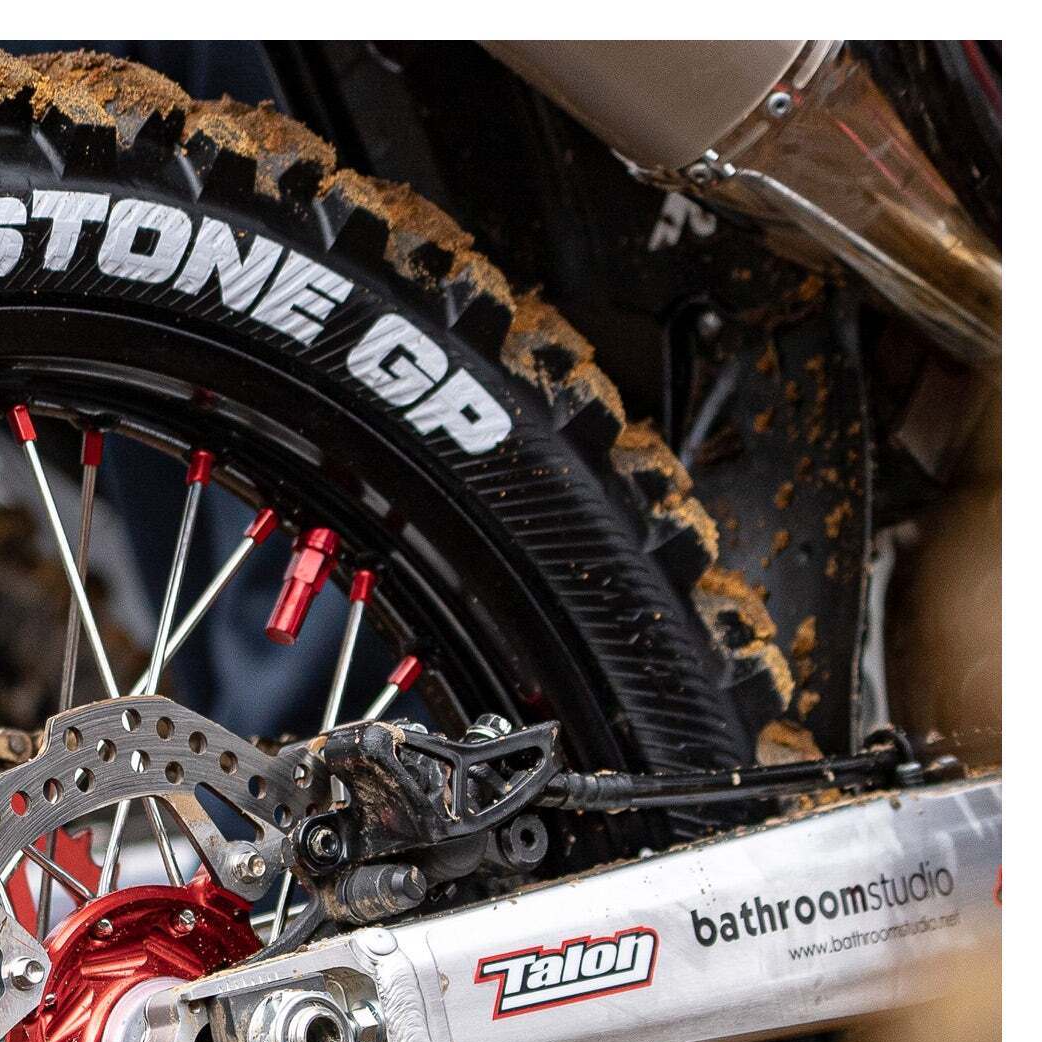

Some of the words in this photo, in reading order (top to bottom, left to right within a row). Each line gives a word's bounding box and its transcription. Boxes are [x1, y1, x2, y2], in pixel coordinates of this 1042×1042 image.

[345, 311, 514, 455] GP
[690, 860, 955, 948] bathroomstudio
[482, 931, 657, 1011] Talon
